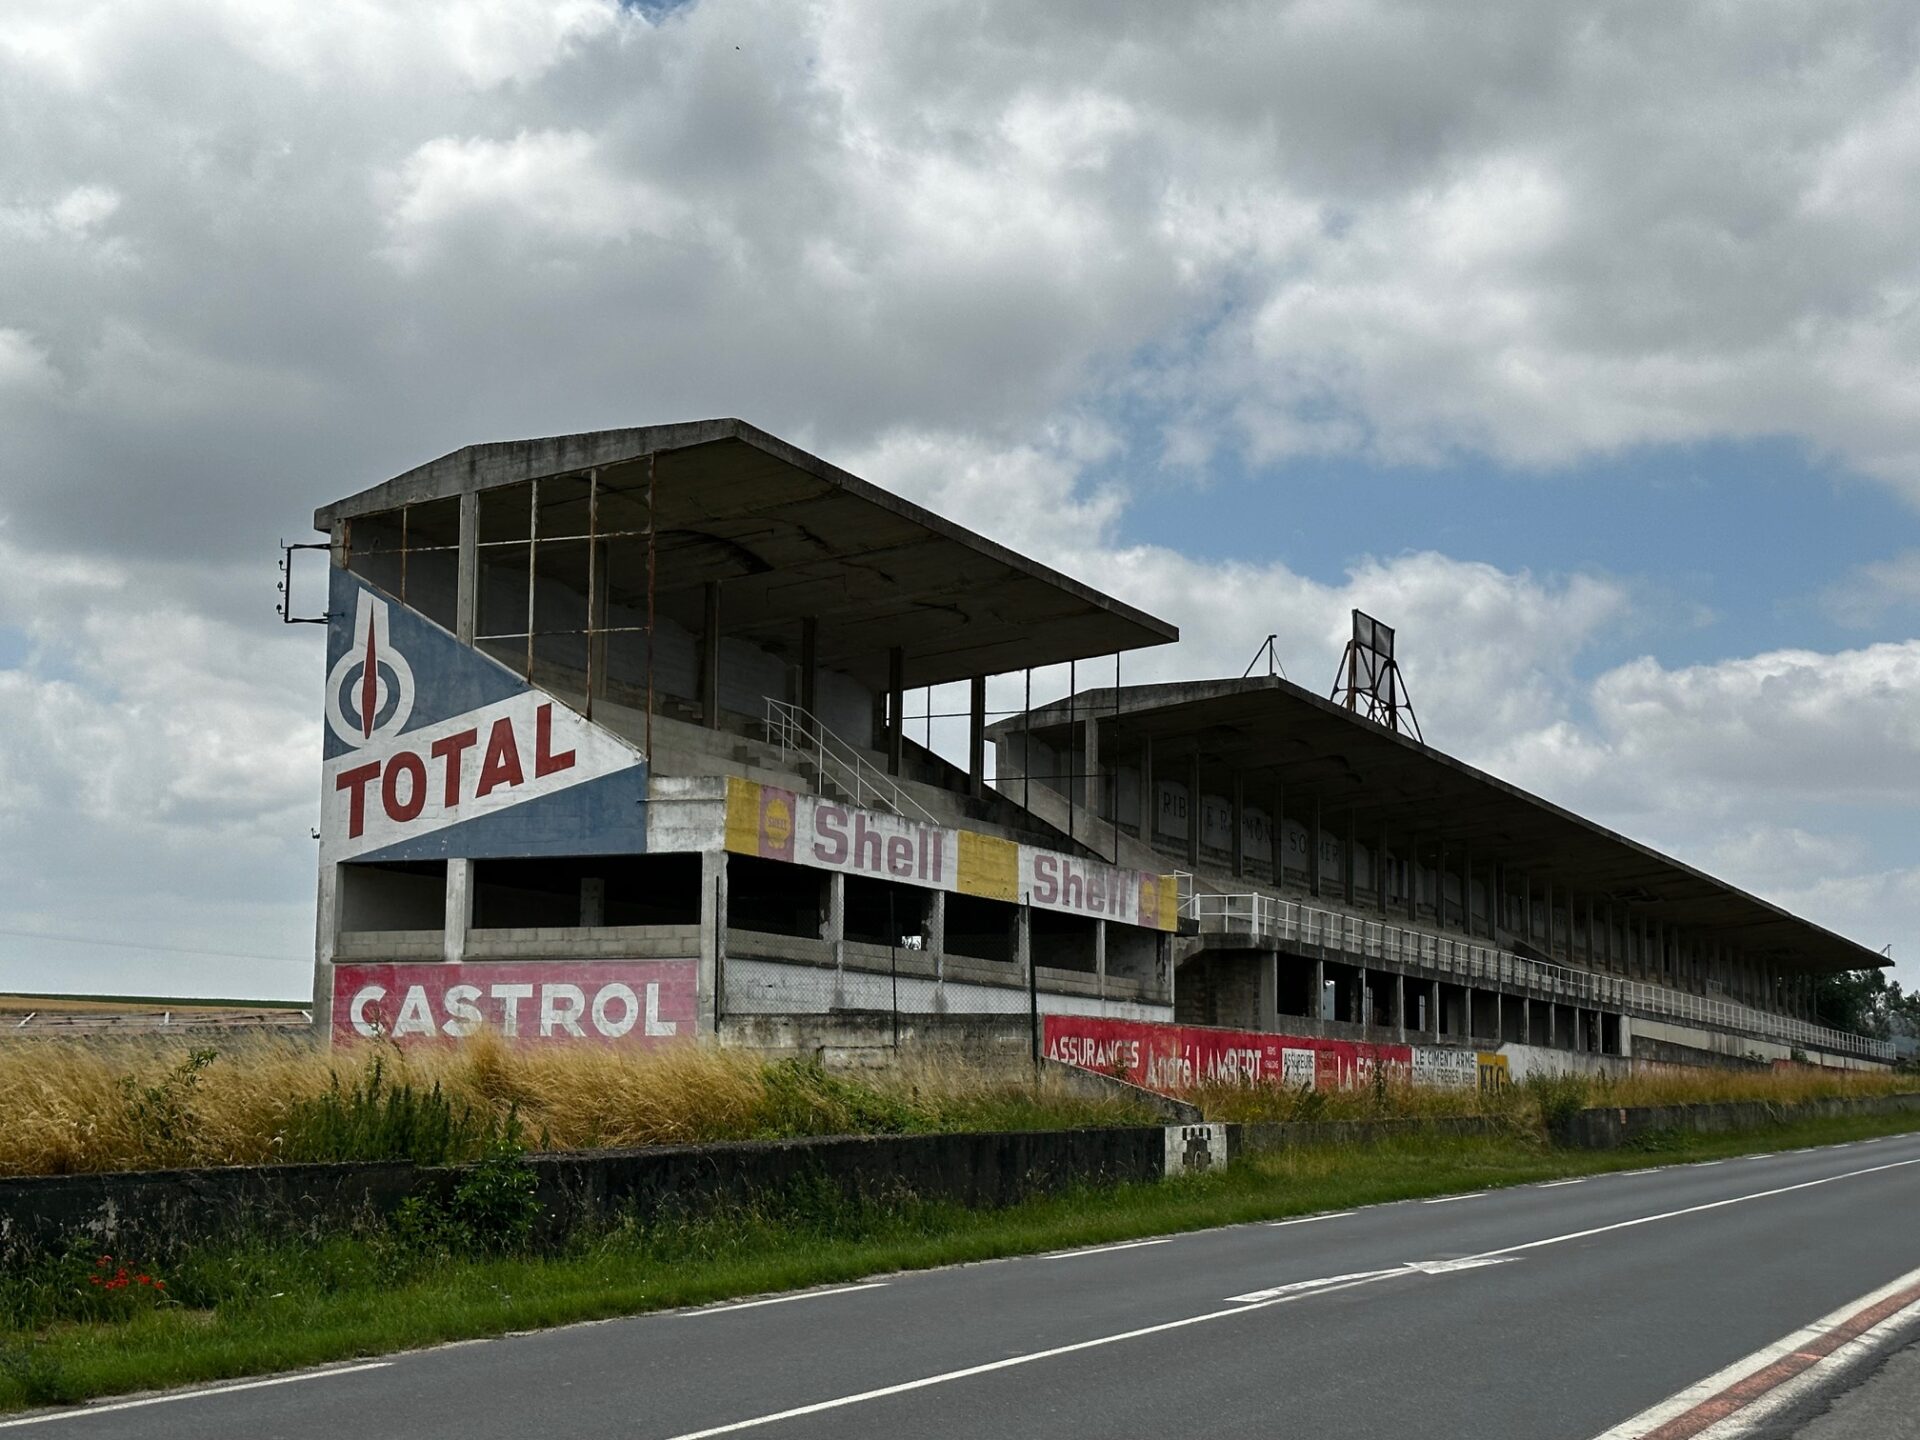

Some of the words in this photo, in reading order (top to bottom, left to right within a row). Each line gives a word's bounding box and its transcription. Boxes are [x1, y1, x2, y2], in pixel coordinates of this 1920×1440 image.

[336, 703, 576, 839] TOTAL
[814, 805, 944, 883] Shell
[1033, 854, 1128, 918] Shell
[349, 982, 677, 1039] CASTROL
[1049, 1036, 1139, 1068] ASSURANCES
[1145, 1041, 1191, 1090] André
[1195, 1045, 1262, 1090] LAMBERT
[1338, 1055, 1353, 1092] LA
[1415, 1049, 1424, 1065] LE
[1428, 1050, 1453, 1068] CIMENT
